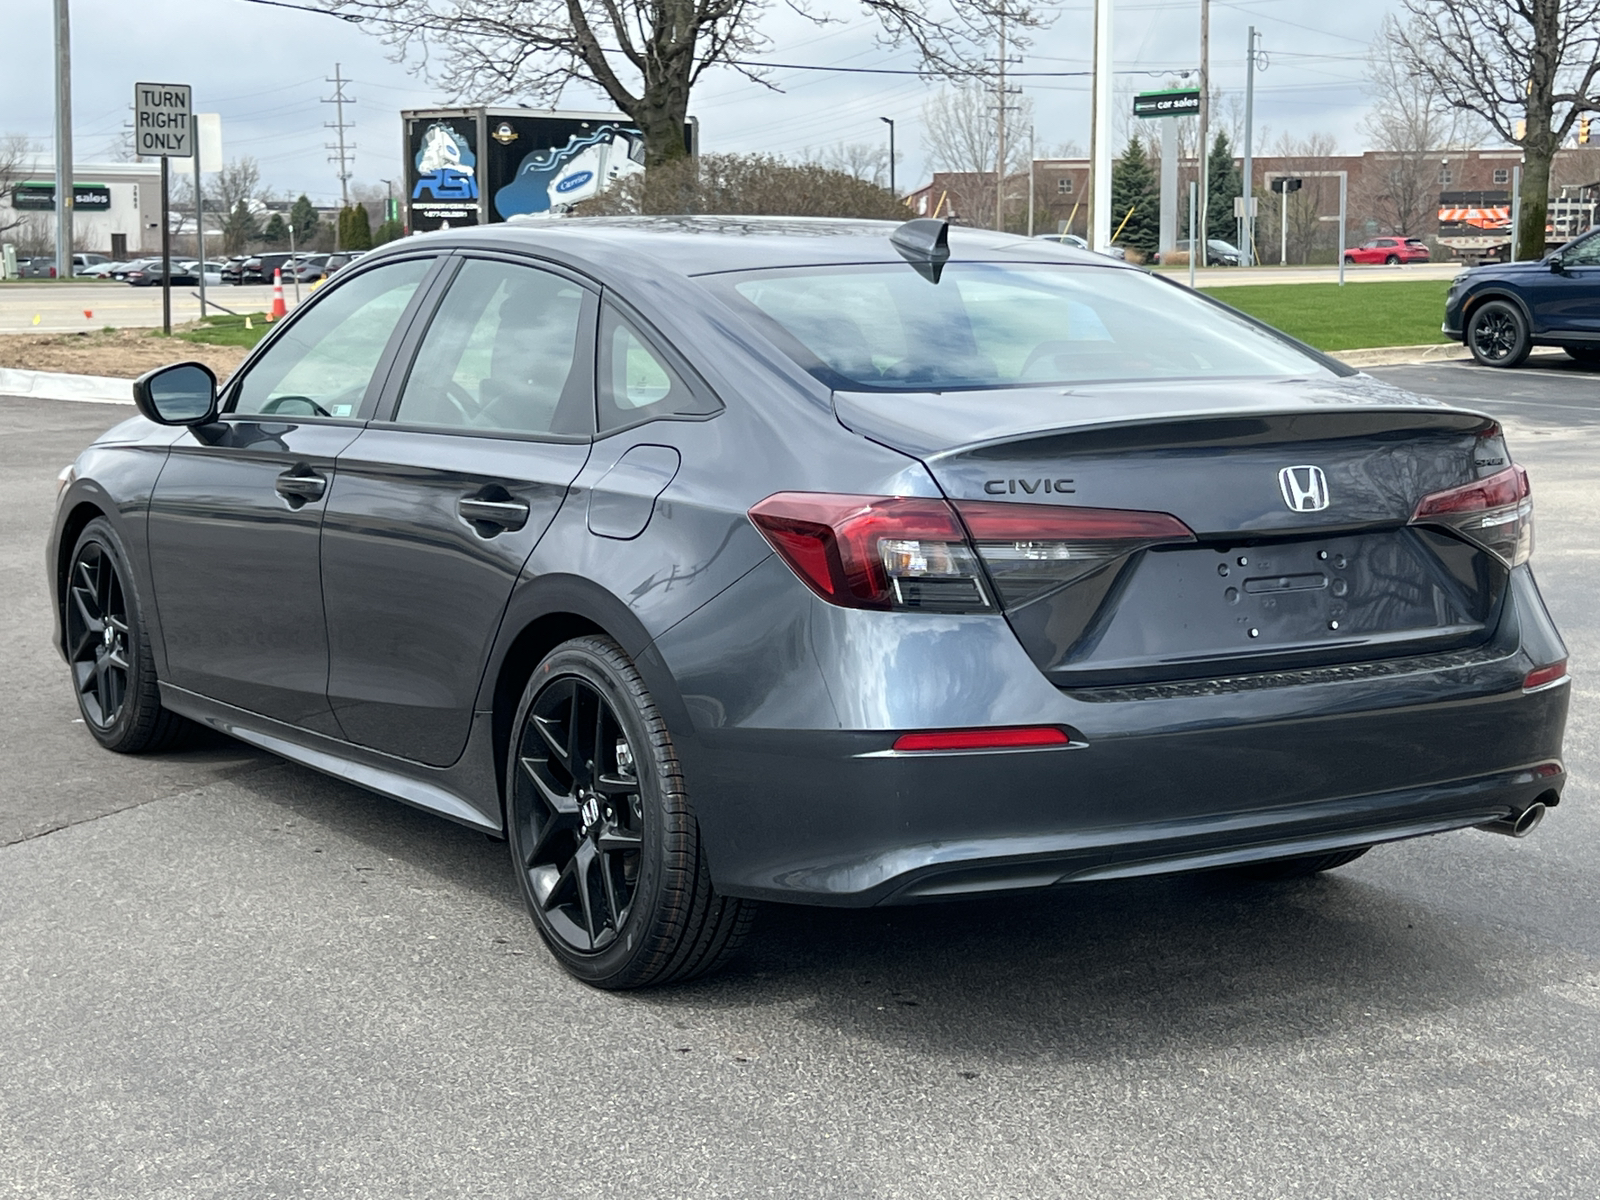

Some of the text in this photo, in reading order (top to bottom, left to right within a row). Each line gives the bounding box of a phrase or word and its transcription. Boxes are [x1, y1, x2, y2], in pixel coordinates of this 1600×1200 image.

[142, 90, 186, 108] TURN
[1157, 100, 1173, 110] car
[1173, 97, 1198, 108] sales
[140, 111, 187, 129] RIGHT
[143, 132, 186, 150] ONLY
[75, 192, 108, 203] sales
[984, 478, 1076, 494] CIVIC
